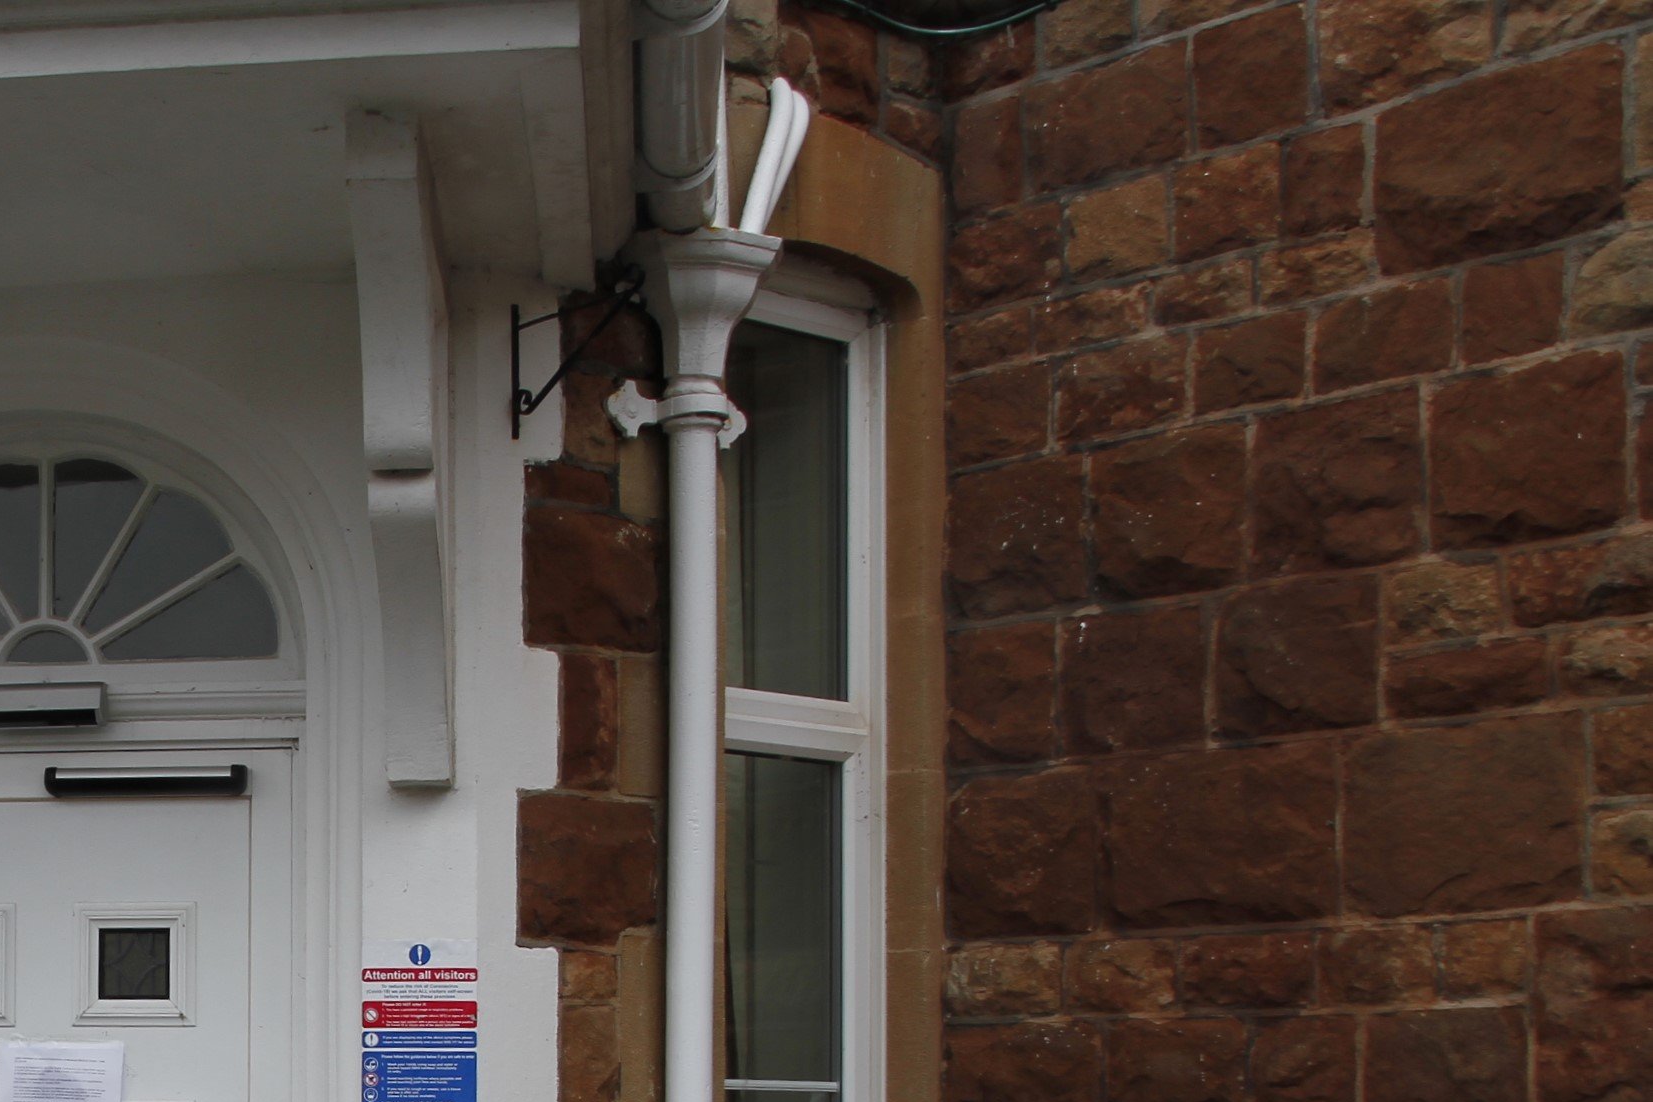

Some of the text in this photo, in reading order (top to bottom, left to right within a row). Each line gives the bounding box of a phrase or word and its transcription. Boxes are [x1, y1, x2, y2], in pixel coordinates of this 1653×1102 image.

[364, 970, 476, 980] Attention all visitors
